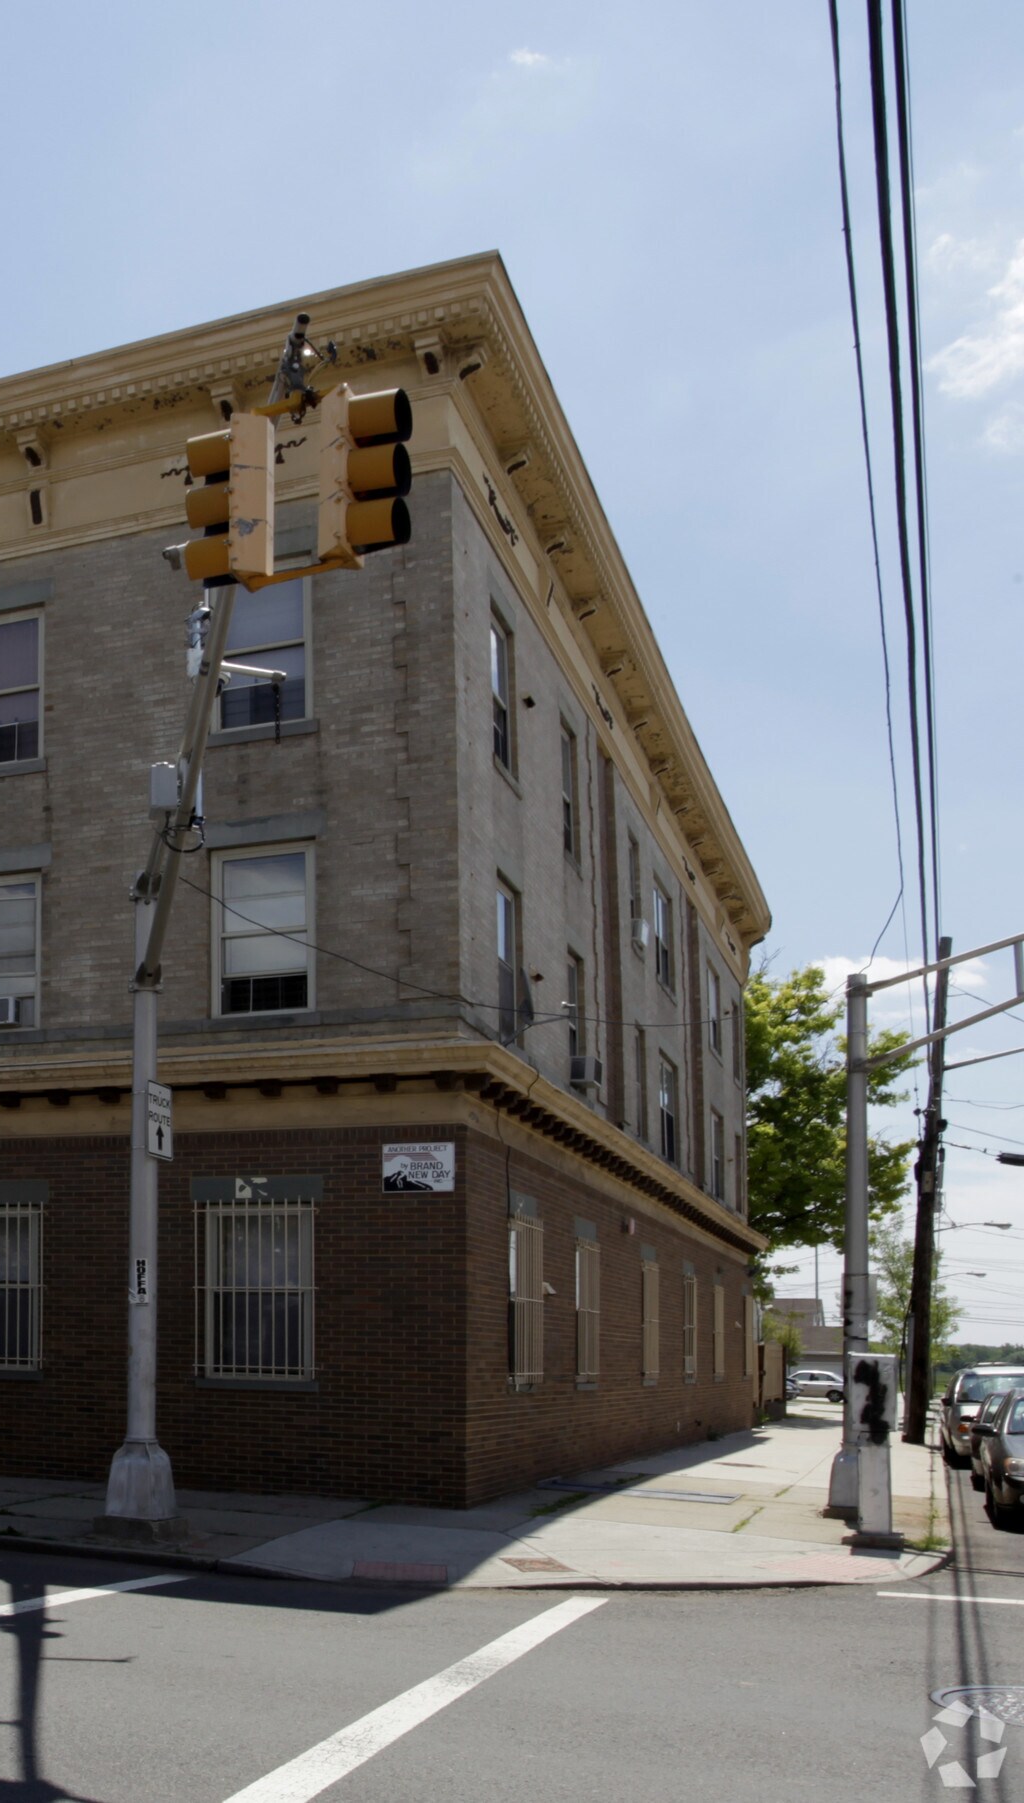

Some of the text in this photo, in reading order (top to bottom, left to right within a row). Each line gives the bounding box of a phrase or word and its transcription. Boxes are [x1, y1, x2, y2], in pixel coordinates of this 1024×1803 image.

[148, 1093, 170, 1108] TRUCK
[148, 1110, 171, 1127] ROUTE
[410, 1161, 443, 1170] BRAND
[408, 1170, 451, 1179] NEW DAY
[136, 1259, 146, 1294] HOFFA
